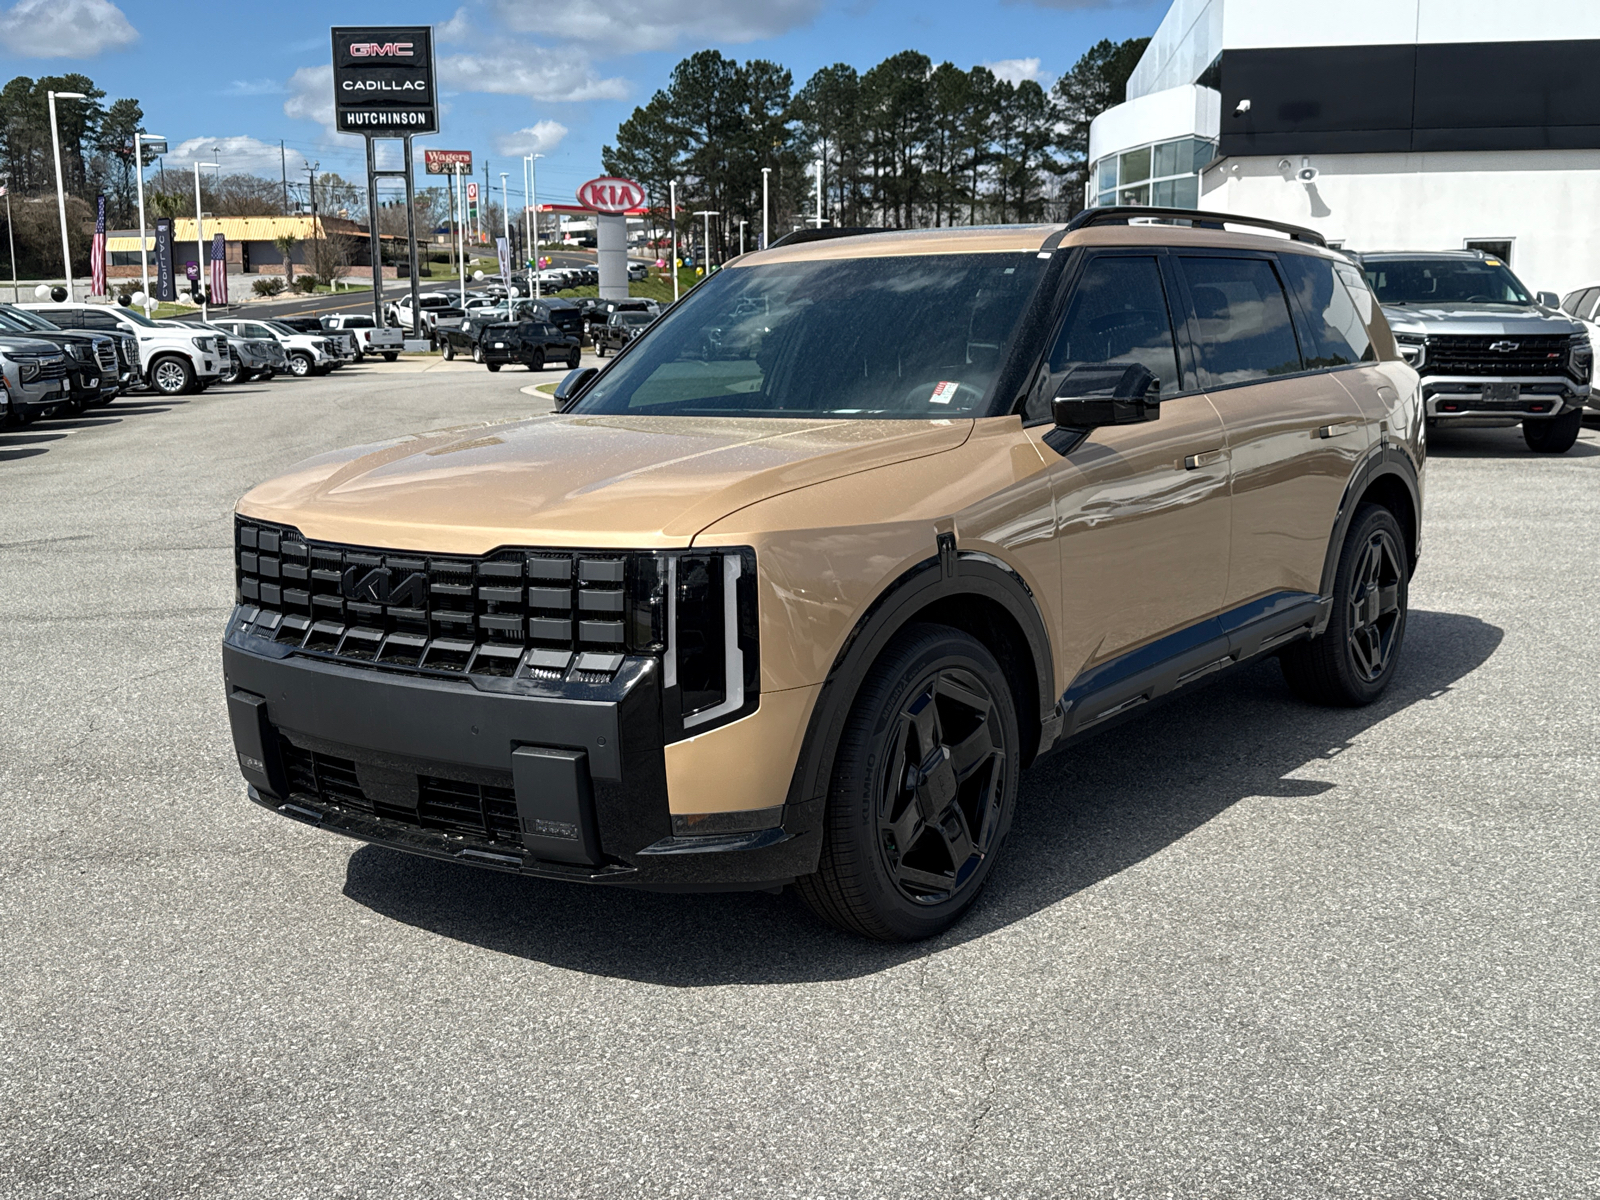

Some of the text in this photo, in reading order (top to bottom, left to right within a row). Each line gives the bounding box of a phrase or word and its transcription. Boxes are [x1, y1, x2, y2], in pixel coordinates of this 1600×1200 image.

[350, 43, 414, 57] GMC
[342, 81, 426, 90] CADILLAC
[347, 113, 426, 125] HUTCHINSON
[427, 151, 470, 163] Wagers
[591, 185, 635, 205] KIA
[344, 565, 427, 609] KIA
[861, 753, 876, 825] KUMHO
